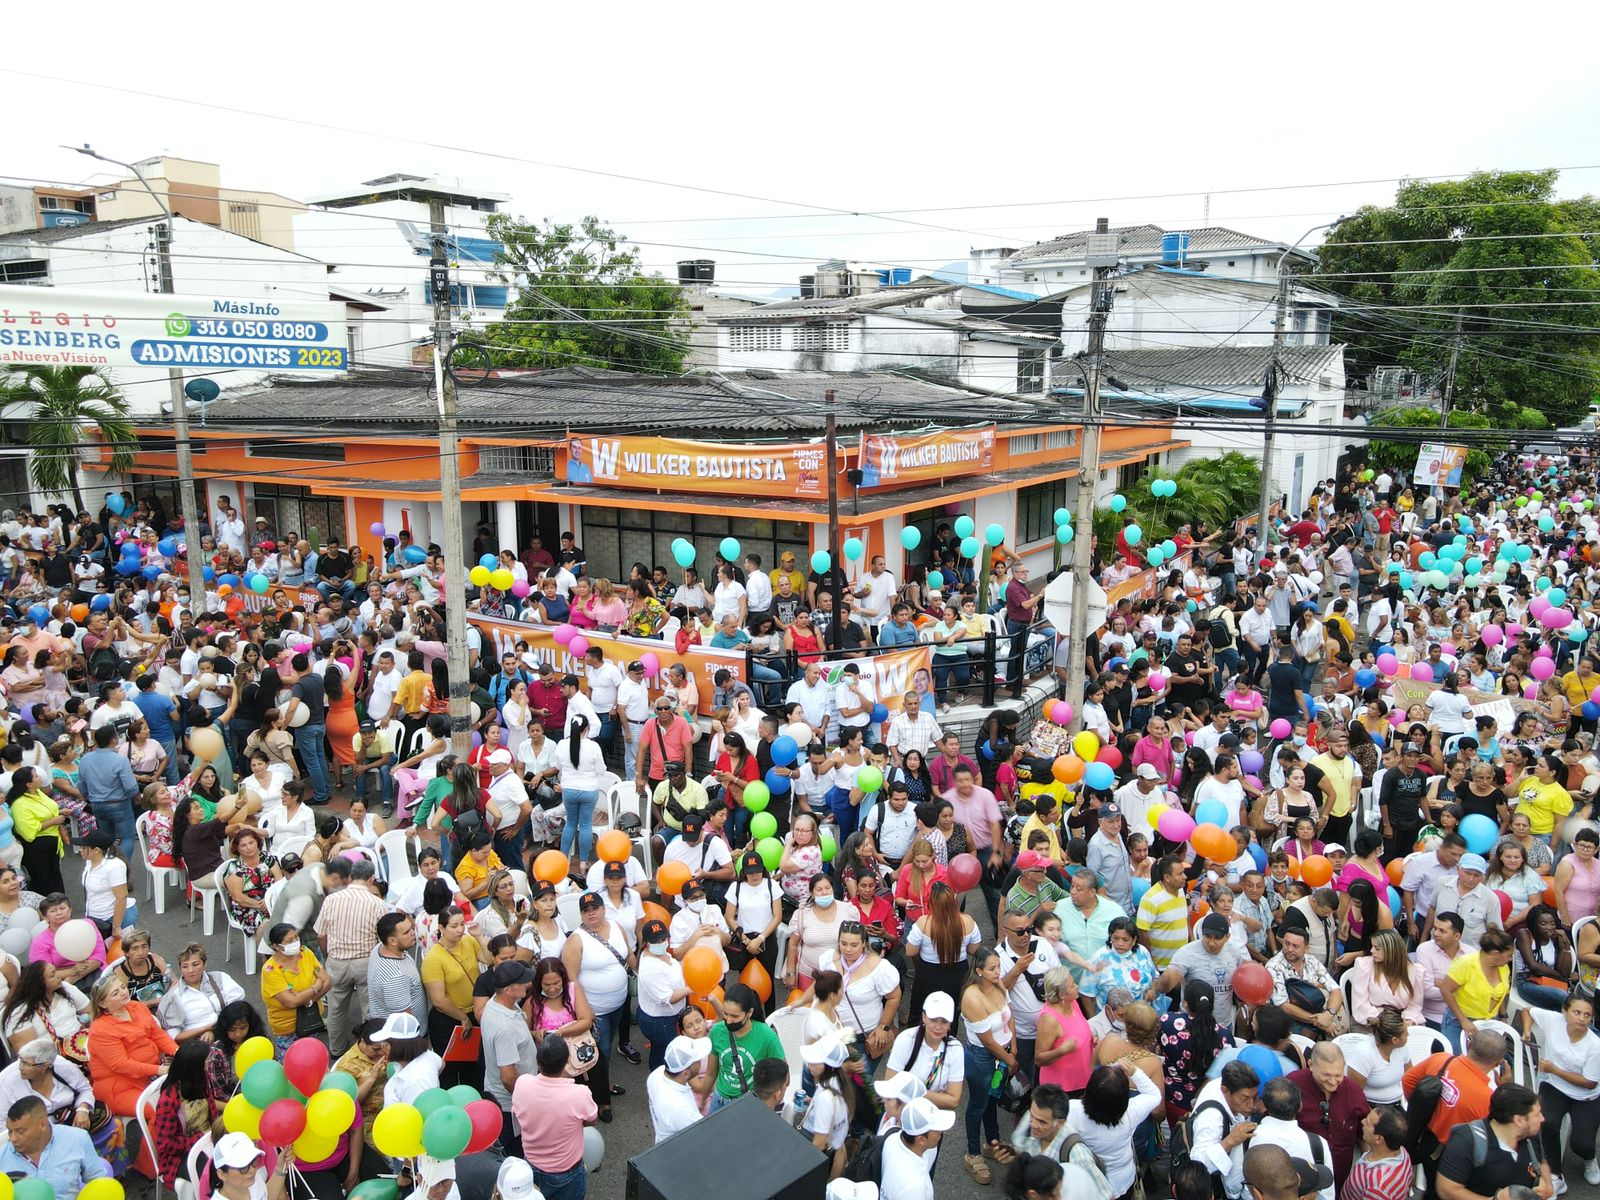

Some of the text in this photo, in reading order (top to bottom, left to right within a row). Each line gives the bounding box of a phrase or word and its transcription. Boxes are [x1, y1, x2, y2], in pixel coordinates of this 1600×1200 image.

[213, 300, 280, 316] MásInfo
[0, 329, 121, 349] SENBERG
[196, 319, 317, 340] 316 050 8080
[0, 351, 108, 363] aNuevaVisión
[139, 343, 343, 367] ADMISIONES 2023
[591, 439, 619, 476] W
[793, 450, 825, 459] FIRMES
[798, 459, 819, 470] CON
[900, 445, 938, 468] WILKER
[940, 441, 980, 464] BAUTISTA
[623, 450, 787, 481] WILKER BAUTISTA
[528, 645, 590, 677] WILKE
[875, 660, 909, 693] W
[1214, 984, 1233, 993] ULLS
